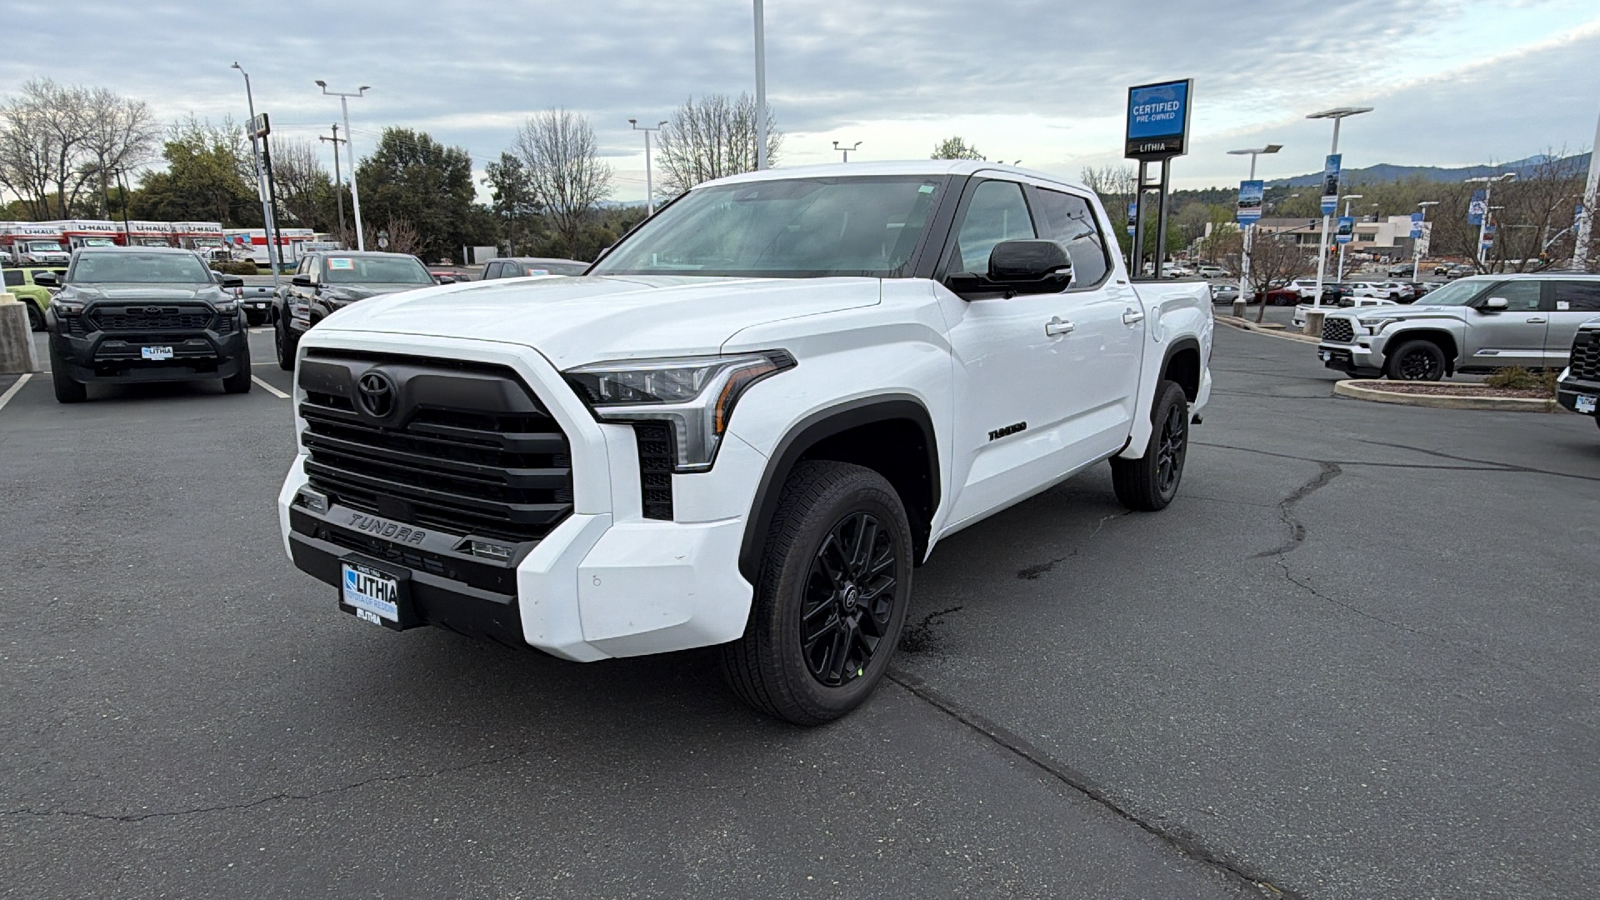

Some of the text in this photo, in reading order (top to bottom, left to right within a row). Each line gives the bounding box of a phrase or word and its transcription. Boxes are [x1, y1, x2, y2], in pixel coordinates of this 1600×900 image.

[1133, 101, 1180, 115] CERTIFIED
[1136, 112, 1176, 123] PRE-OWNED
[1139, 142, 1166, 153] LITHIA
[988, 421, 1027, 442] TUNDRA
[348, 513, 426, 545] TUNDRA
[346, 589, 365, 604] TOYOTA
[365, 597, 373, 606] OF
[357, 573, 398, 606] LITHIA
